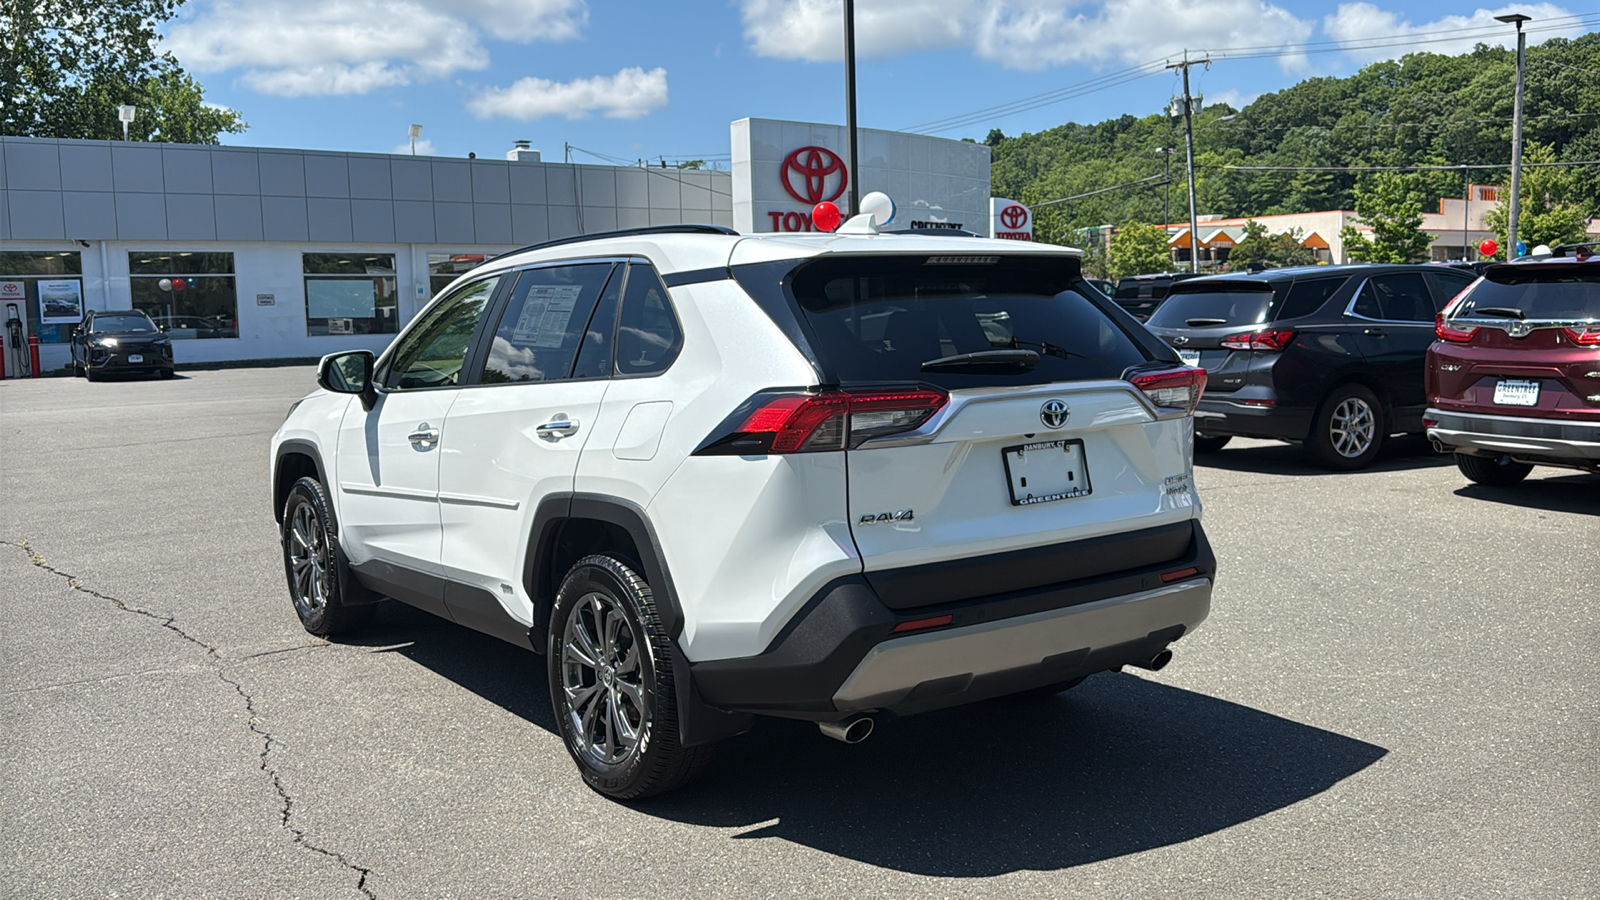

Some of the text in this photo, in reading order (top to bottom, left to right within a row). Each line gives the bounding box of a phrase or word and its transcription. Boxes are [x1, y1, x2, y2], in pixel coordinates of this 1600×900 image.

[996, 232, 1031, 240] TOYOTA
[1497, 384, 1536, 393] GREENTREE
[1020, 489, 1089, 504] GREENTREE
[858, 508, 914, 526] RAV4
